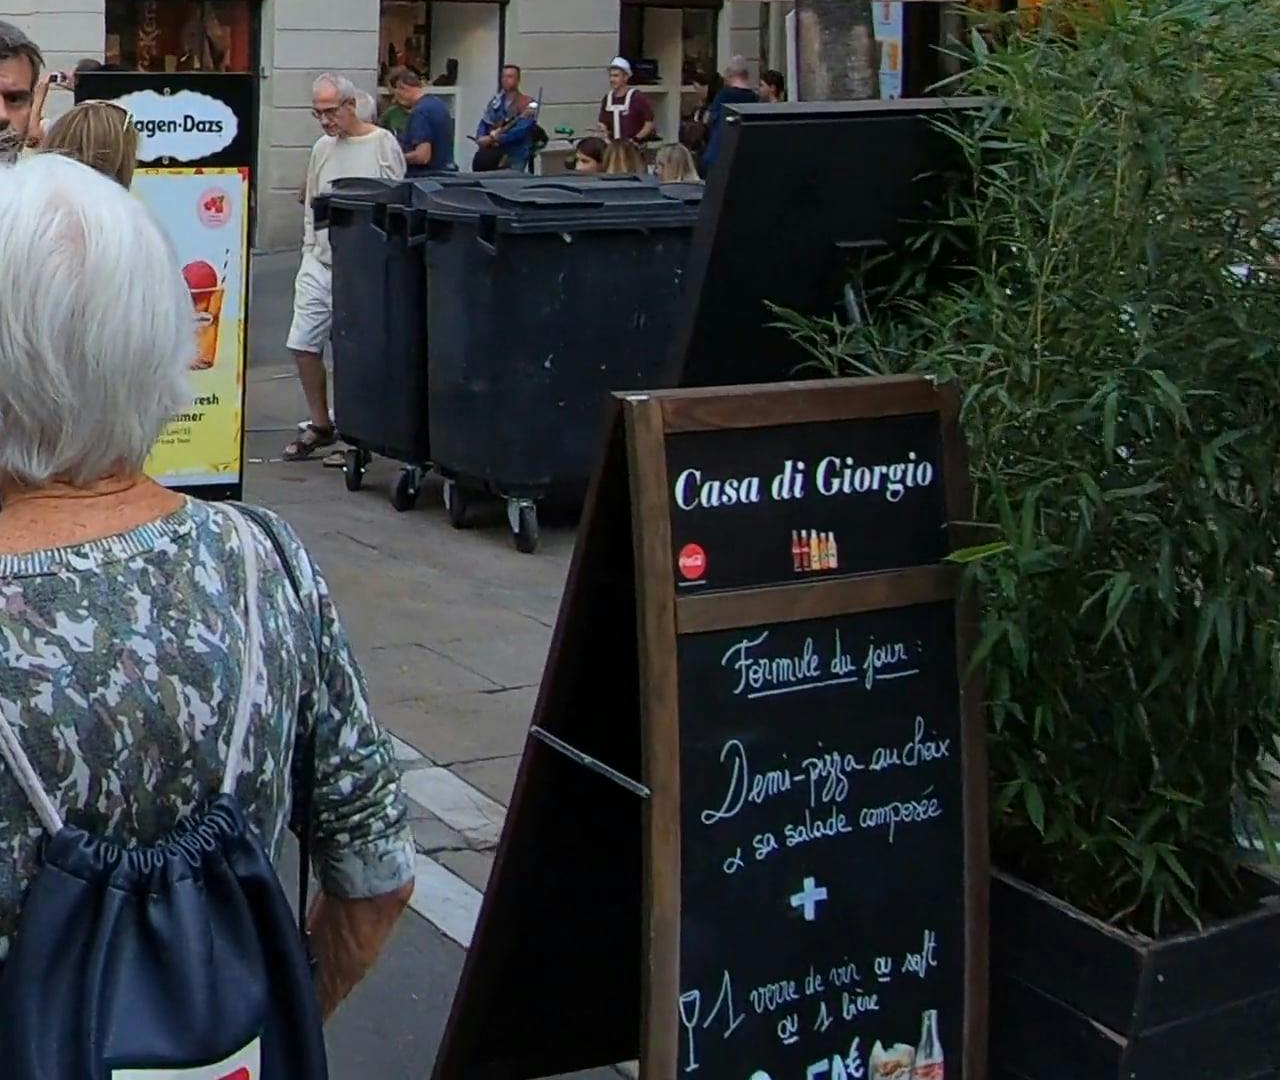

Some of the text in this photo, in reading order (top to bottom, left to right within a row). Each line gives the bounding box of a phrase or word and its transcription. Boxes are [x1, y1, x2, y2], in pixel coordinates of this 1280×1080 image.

[134, 114, 224, 138] agen-Dazs
[194, 393, 219, 406] resh
[674, 451, 934, 511] Casa di Giorgio
[721, 630, 821, 695] Formule
[830, 628, 857, 675] du
[700, 715, 951, 825] Demi-pizza au choix
[752, 832, 779, 860] sa
[783, 805, 853, 847] salade
[858, 785, 943, 844] composée
[749, 979, 801, 1013] verre
[804, 965, 825, 996] de
[828, 955, 861, 987] vin
[874, 955, 892, 976] ou
[901, 929, 938, 979] soft
[842, 987, 881, 1021] bière
